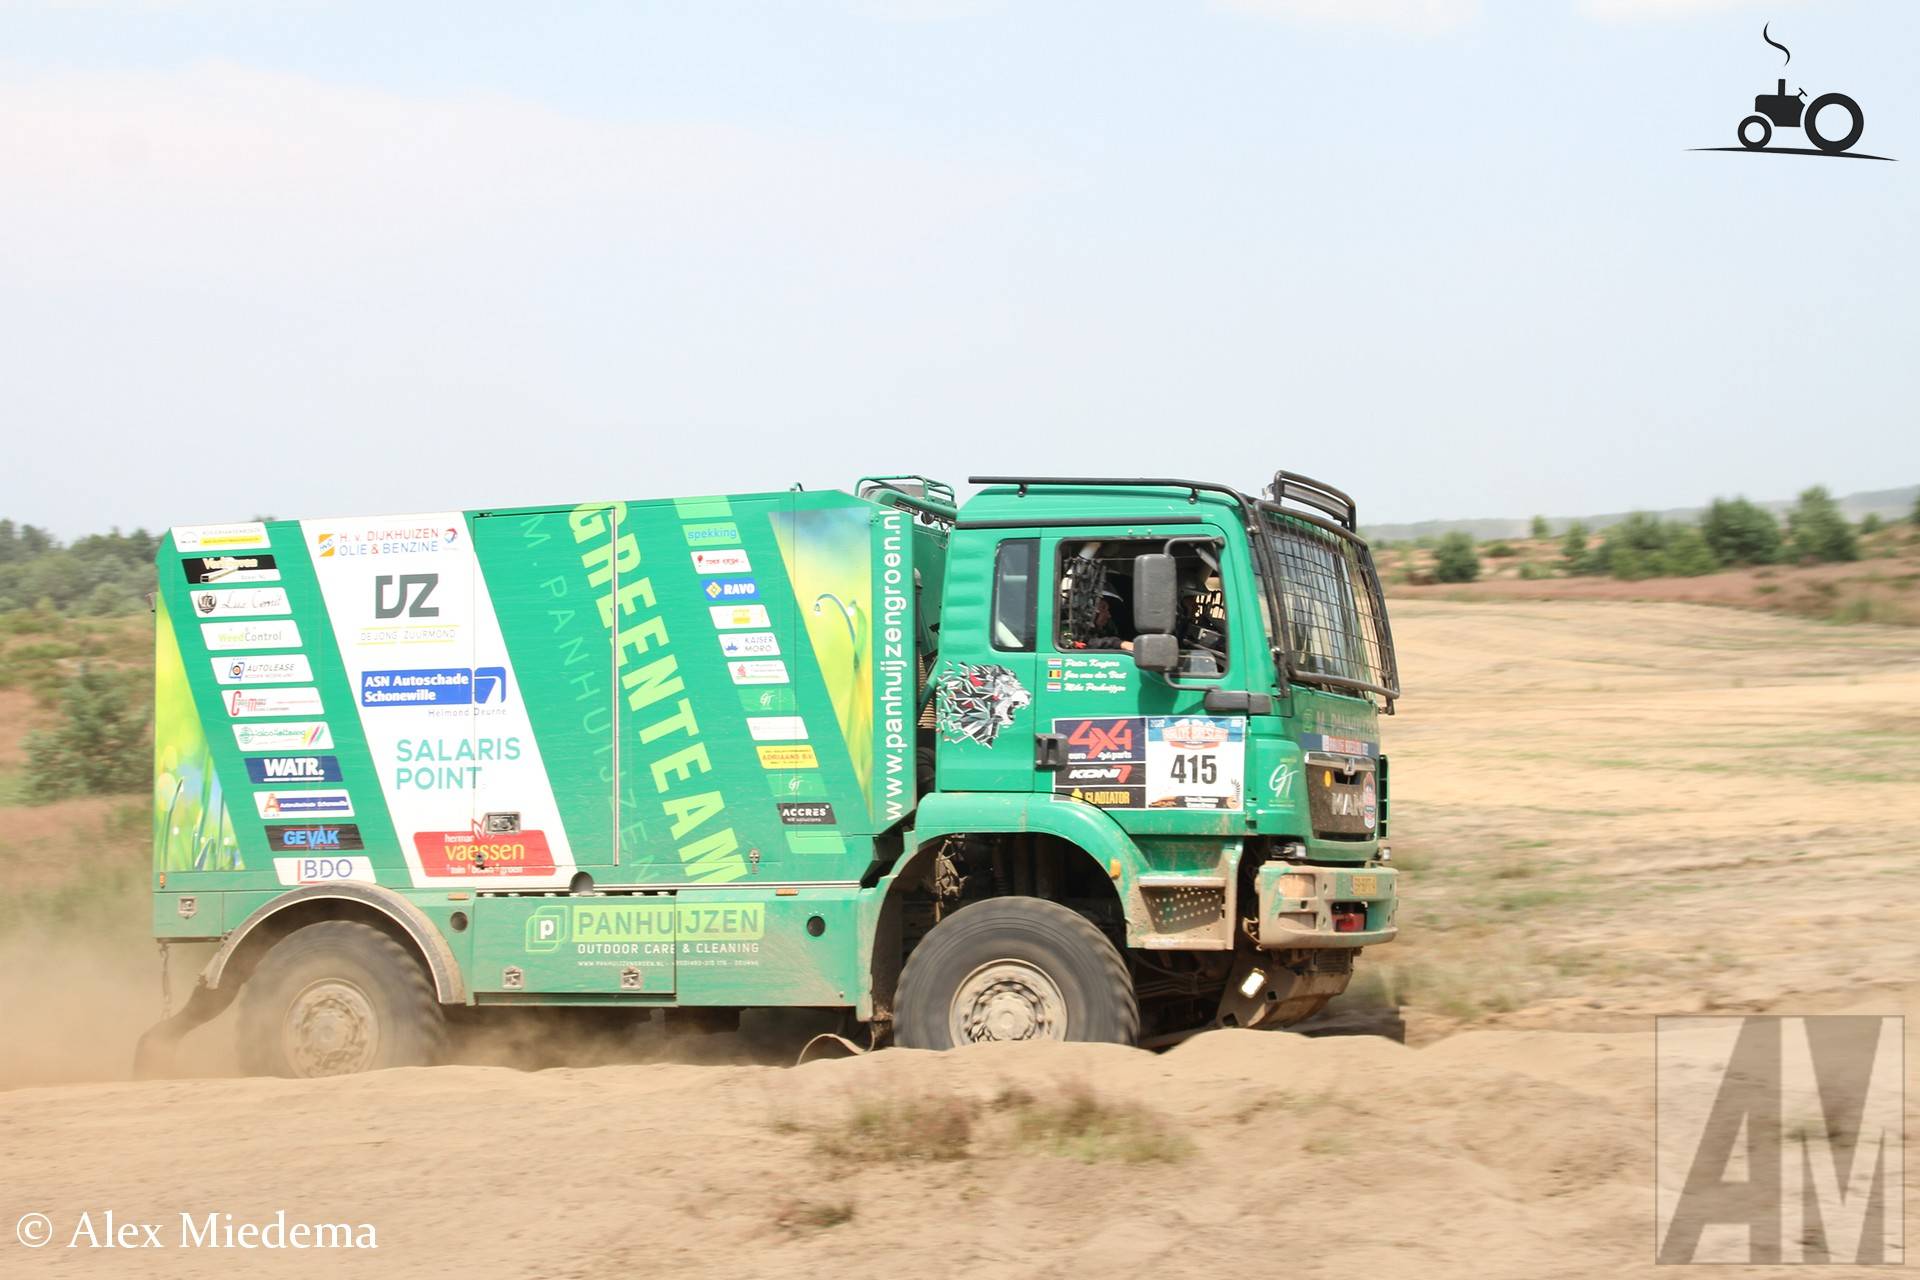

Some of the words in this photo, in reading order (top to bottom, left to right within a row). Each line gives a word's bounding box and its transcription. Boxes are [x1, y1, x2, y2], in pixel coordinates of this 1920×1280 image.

[367, 528, 439, 541] DIJKHUIZEN
[687, 528, 737, 541] spekking
[339, 544, 368, 556] OLIE
[371, 543, 379, 554] &
[382, 541, 439, 554] BENZINE
[723, 583, 756, 595] RAVO
[247, 663, 296, 672] AUTOLEASE
[879, 509, 907, 821] www.panhuijzengroen.nl
[365, 675, 390, 687] ASN
[393, 673, 469, 686] Autoschade
[364, 689, 436, 702] Schonewille
[568, 501, 748, 884] GREENTEAM
[396, 737, 521, 762] SALARIS
[263, 757, 325, 777] WATR.
[1170, 754, 1218, 785] 415
[396, 767, 483, 790] POINT
[1085, 791, 1130, 804] GLADIATOR
[1331, 791, 1365, 816] MAN
[782, 808, 826, 817] ACCRES
[444, 844, 525, 861] vaessen
[303, 859, 353, 879] BDO
[578, 909, 758, 935] PANHUIJZEN
[578, 943, 639, 954] OUTDOOR
[644, 943, 676, 954] CARE
[682, 943, 690, 953] &
[696, 942, 759, 953] CLEANING
